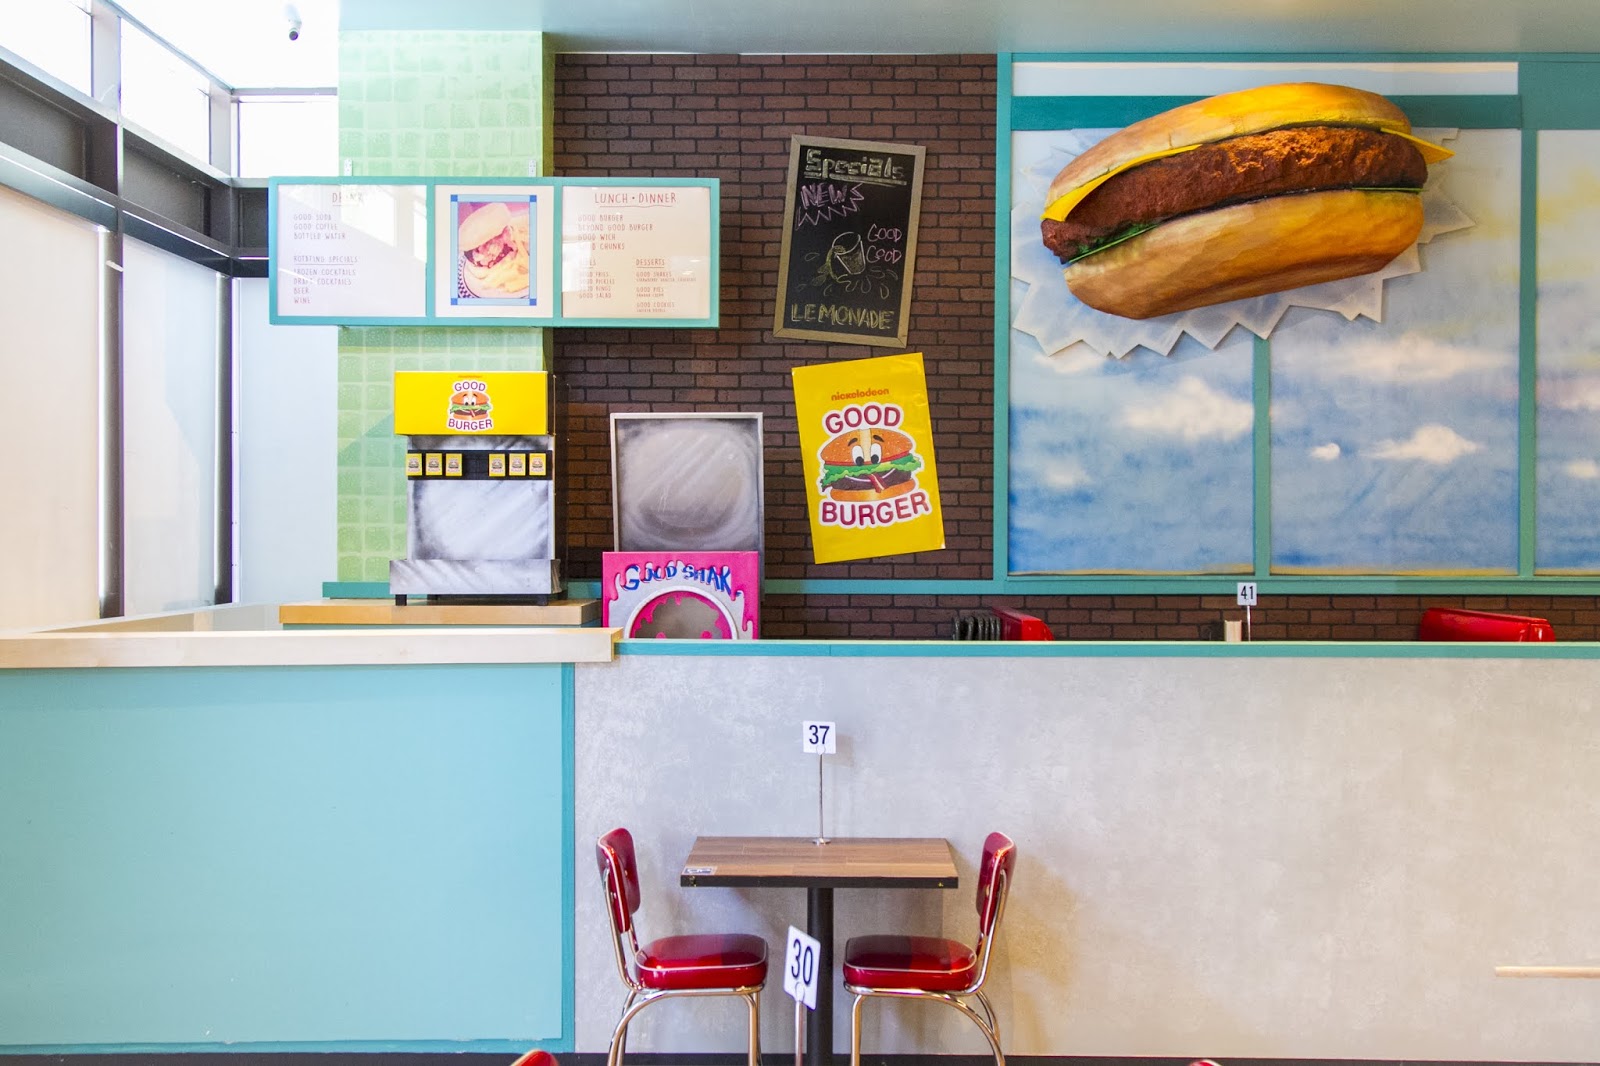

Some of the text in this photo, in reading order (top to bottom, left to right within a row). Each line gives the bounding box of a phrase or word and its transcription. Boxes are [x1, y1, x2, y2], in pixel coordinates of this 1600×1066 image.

[806, 148, 904, 179] Specials
[594, 192, 677, 204] LUNCH DINNER
[800, 182, 848, 209] NEW
[293, 213, 332, 221] GOOD SODA
[578, 214, 624, 222] GOOD BURGER
[293, 223, 338, 231] GOOD COFFEE
[607, 223, 626, 231] GOOD
[629, 223, 654, 231] BURGER
[868, 223, 903, 242] GOOD
[293, 232, 346, 240] BOTTLED WATER
[578, 233, 616, 241] GOOD WICH
[600, 243, 625, 251] CHUNKS
[293, 255, 358, 263] ROTATING SPECIALS
[866, 245, 902, 264] GOOD
[635, 258, 665, 266] DESSERTS
[321, 268, 357, 276] COCKTAILS
[317, 277, 352, 285] COCKTAILS
[293, 287, 310, 295] BEER
[791, 303, 894, 330] LEMONADE
[454, 381, 486, 392] GOOD
[831, 388, 890, 401] nickelodeon
[448, 418, 493, 430] BURGER
[825, 405, 901, 434] GOOD
[822, 493, 929, 526] BURGER
[682, 565, 741, 598] SHAK
[1240, 585, 1254, 600] 41
[808, 724, 830, 745] 37
[791, 938, 813, 986] 30
